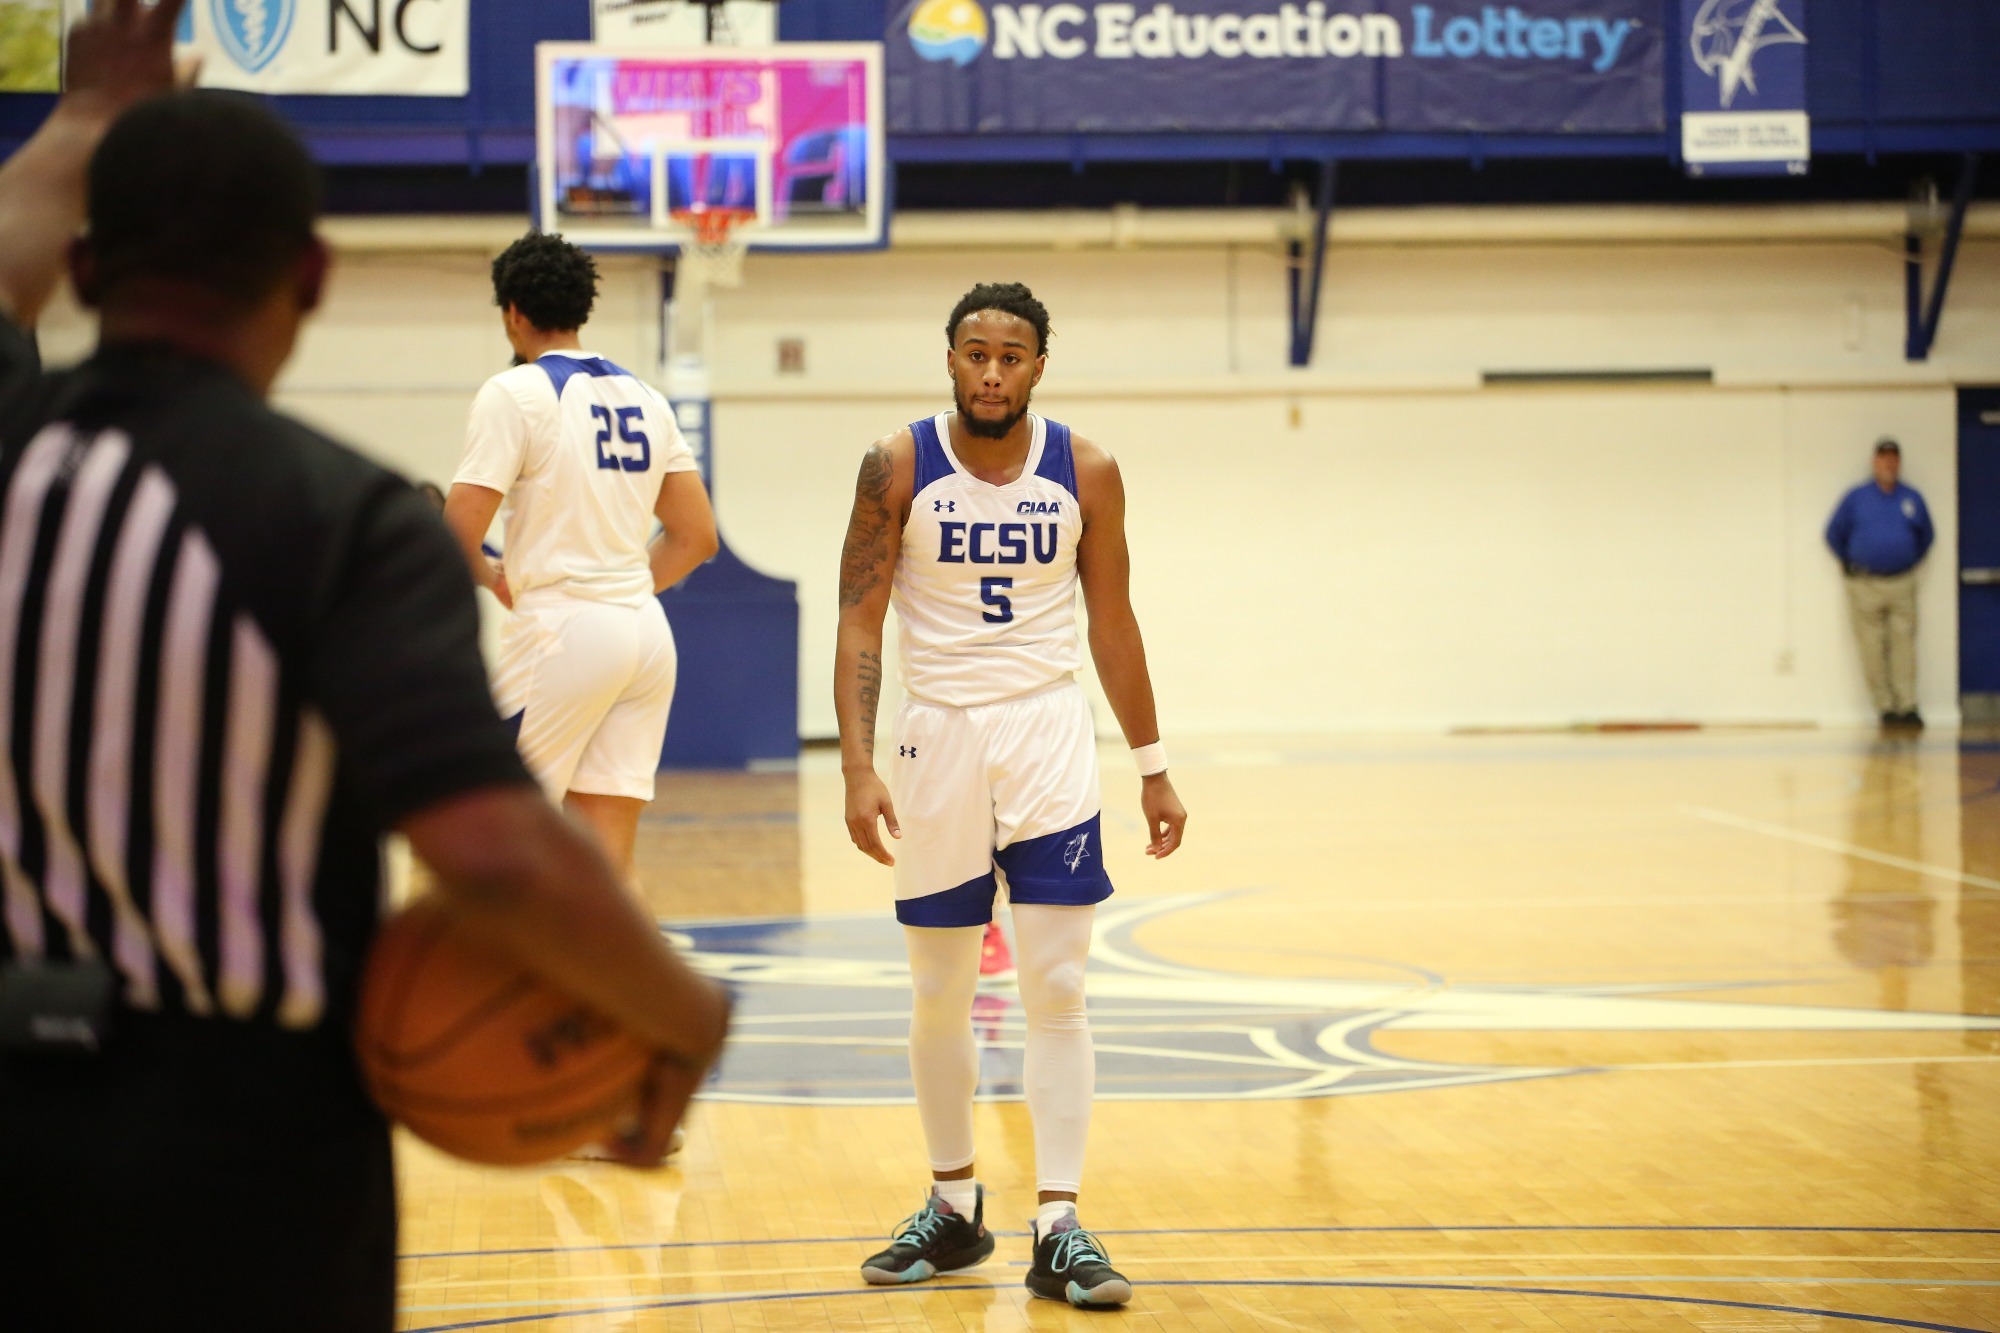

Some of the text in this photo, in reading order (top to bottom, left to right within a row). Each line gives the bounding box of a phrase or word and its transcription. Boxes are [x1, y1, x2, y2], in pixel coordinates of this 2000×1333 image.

[329, 0, 441, 55] NC
[993, 1, 1630, 70] NC Education Lottery
[591, 404, 651, 473] 25
[1016, 501, 1060, 516] CIAA
[937, 521, 1058, 565] ECSU
[980, 576, 1014, 624] 5
